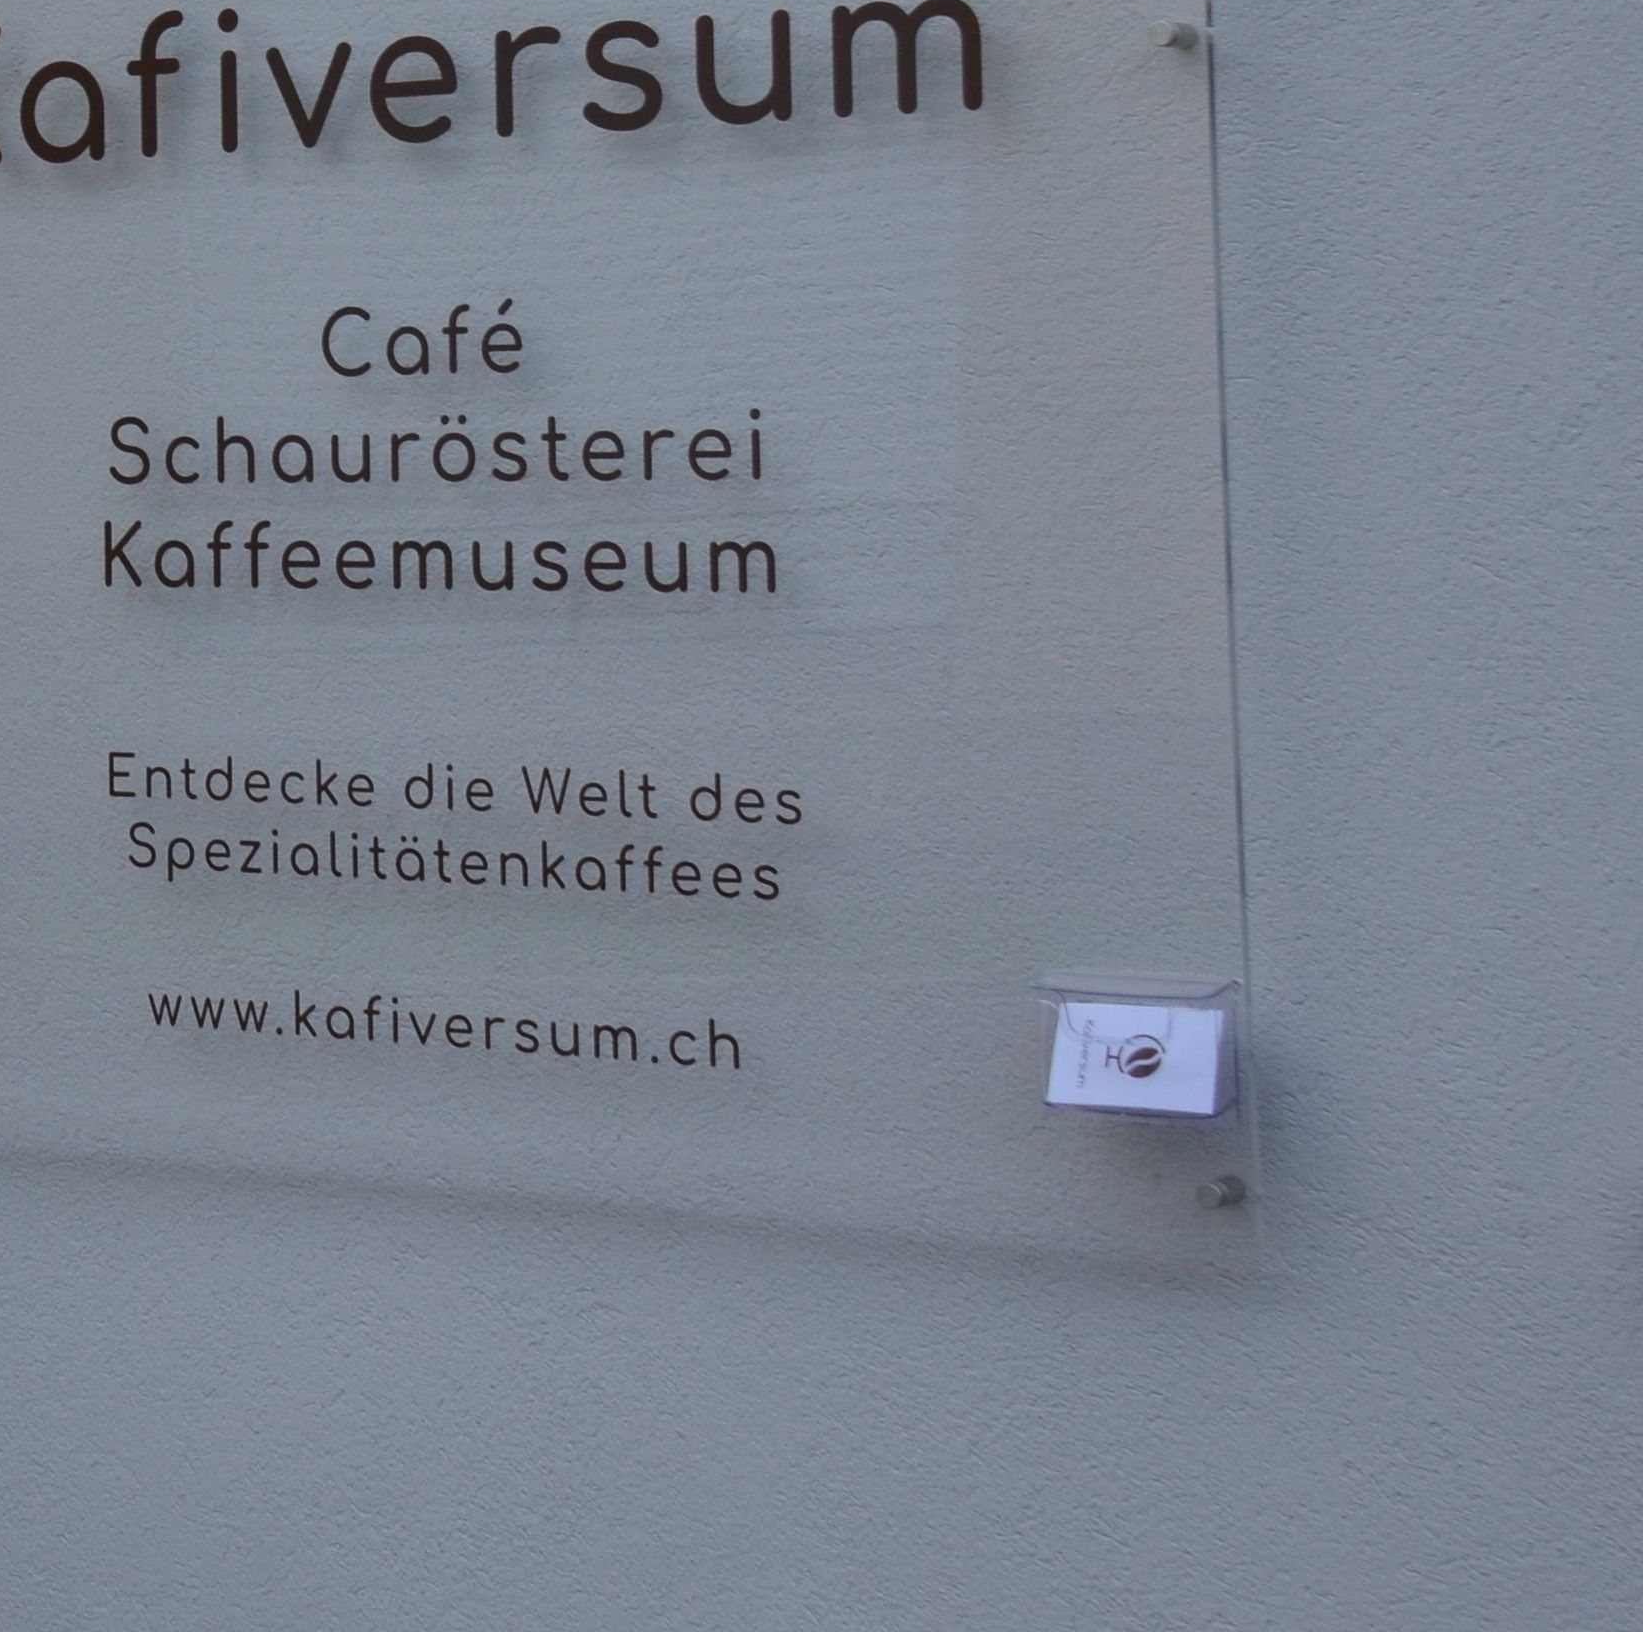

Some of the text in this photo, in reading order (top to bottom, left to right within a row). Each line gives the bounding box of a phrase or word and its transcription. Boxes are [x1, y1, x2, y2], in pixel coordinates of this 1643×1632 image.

[320, 296, 526, 379] Café
[108, 407, 764, 487] Schaurösterei
[102, 519, 779, 595] Kaffeemuseum
[107, 750, 803, 828] Entdecke die Welt des
[127, 820, 781, 902] Spezialitätenkaffees
[147, 988, 742, 1071] www.kafiversum.ch
